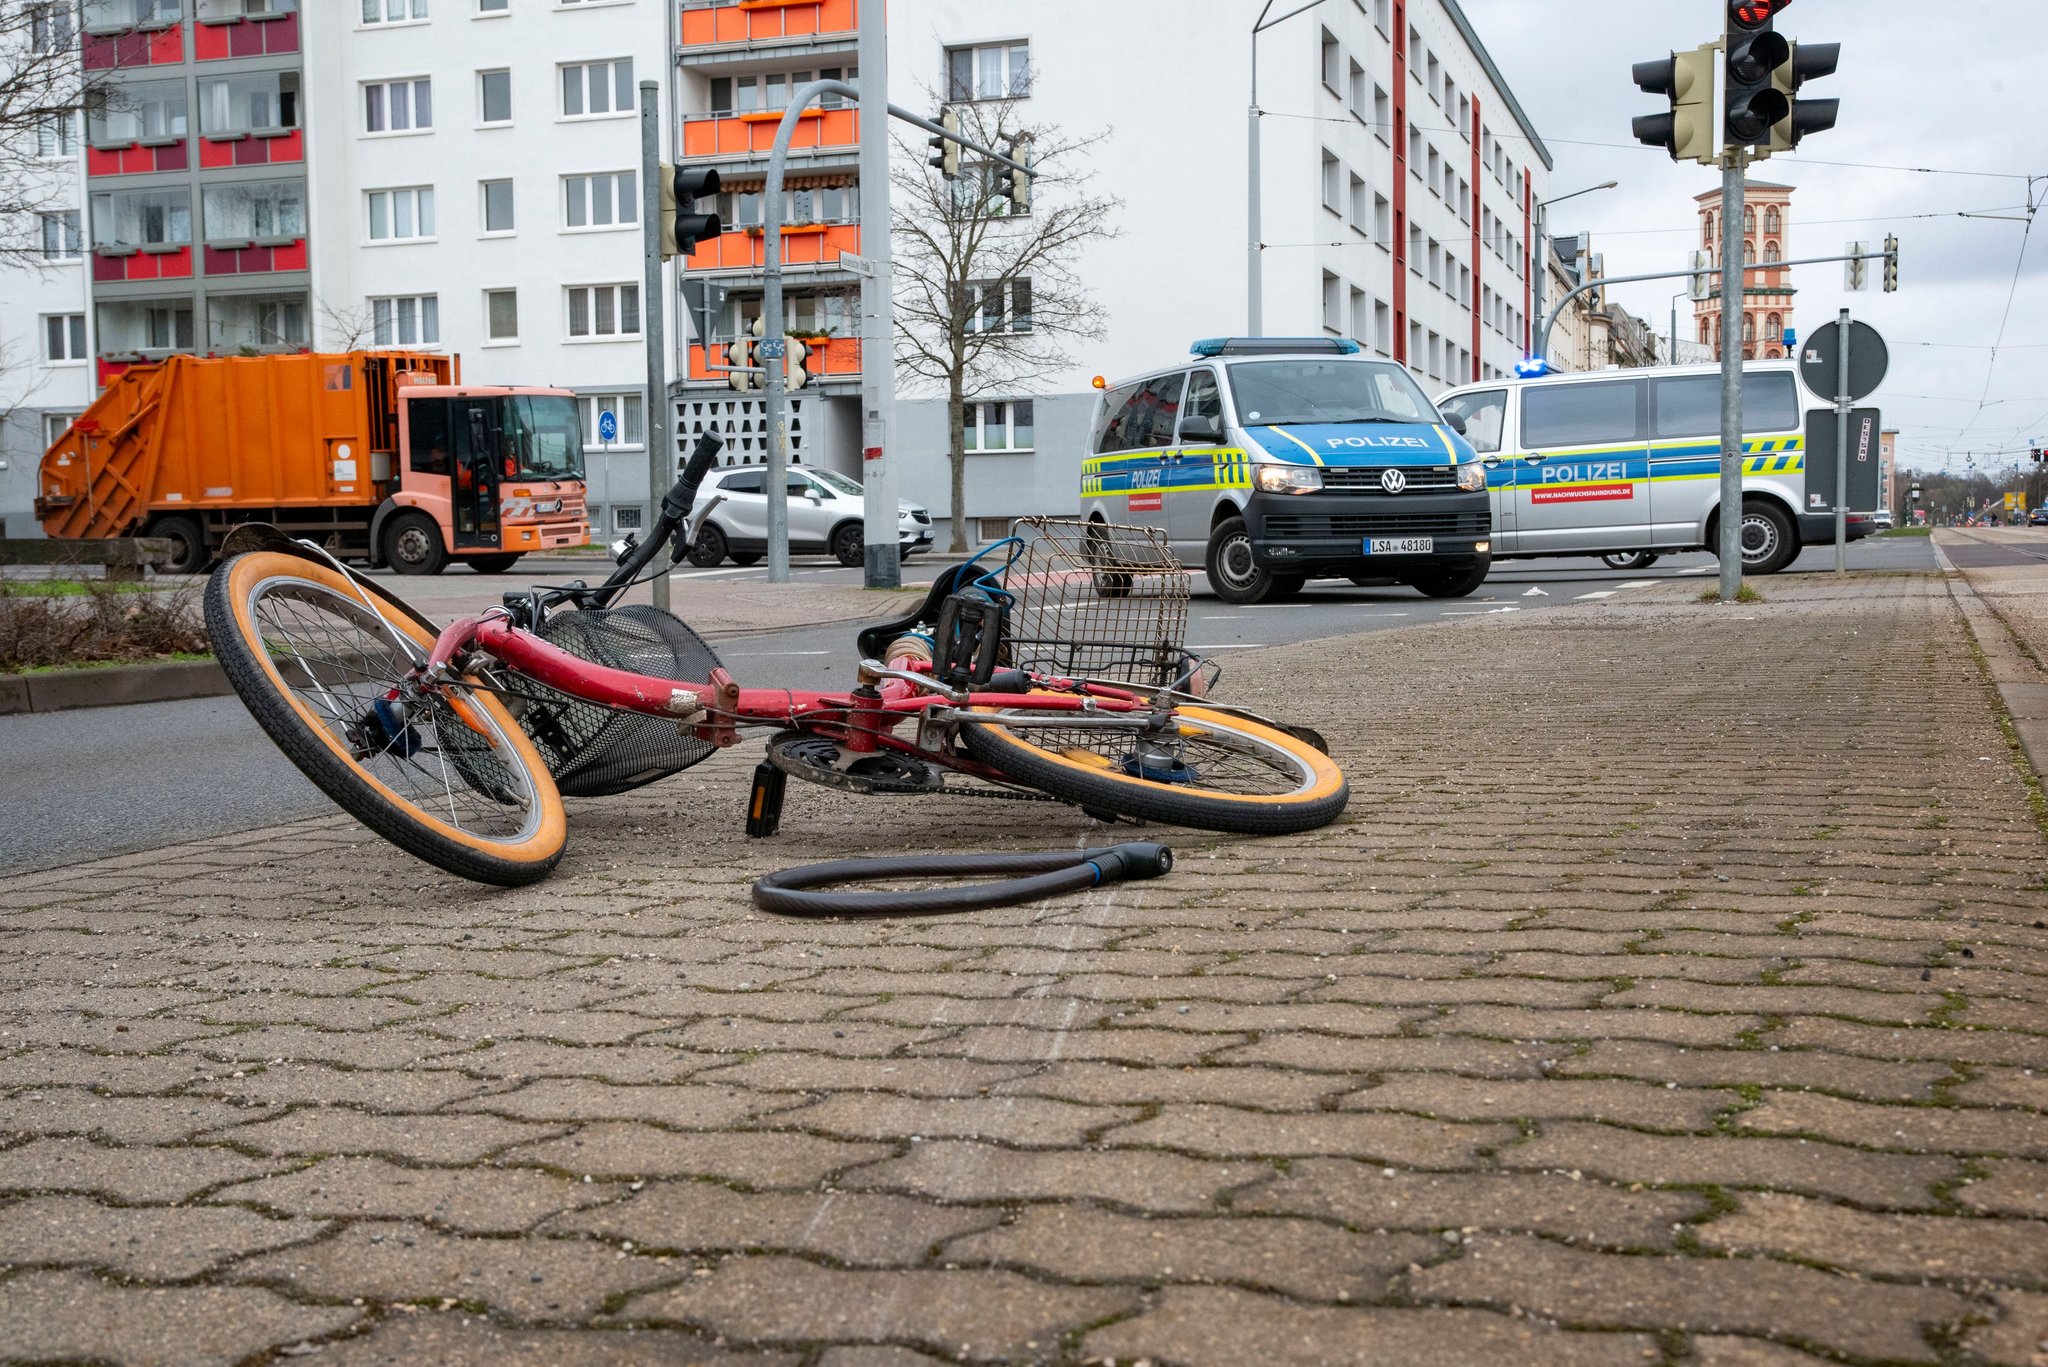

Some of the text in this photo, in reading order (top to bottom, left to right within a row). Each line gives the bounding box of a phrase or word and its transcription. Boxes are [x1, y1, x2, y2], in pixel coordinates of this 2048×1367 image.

[1326, 437, 1429, 448] POLIZEI
[1131, 469, 1161, 488] POLIZEI
[1541, 462, 1627, 483] POLIZEI
[1534, 488, 1630, 499] WWW.NACHWUCHSFAHNDUNG.DE
[1372, 540, 1431, 552] LSA 48180
